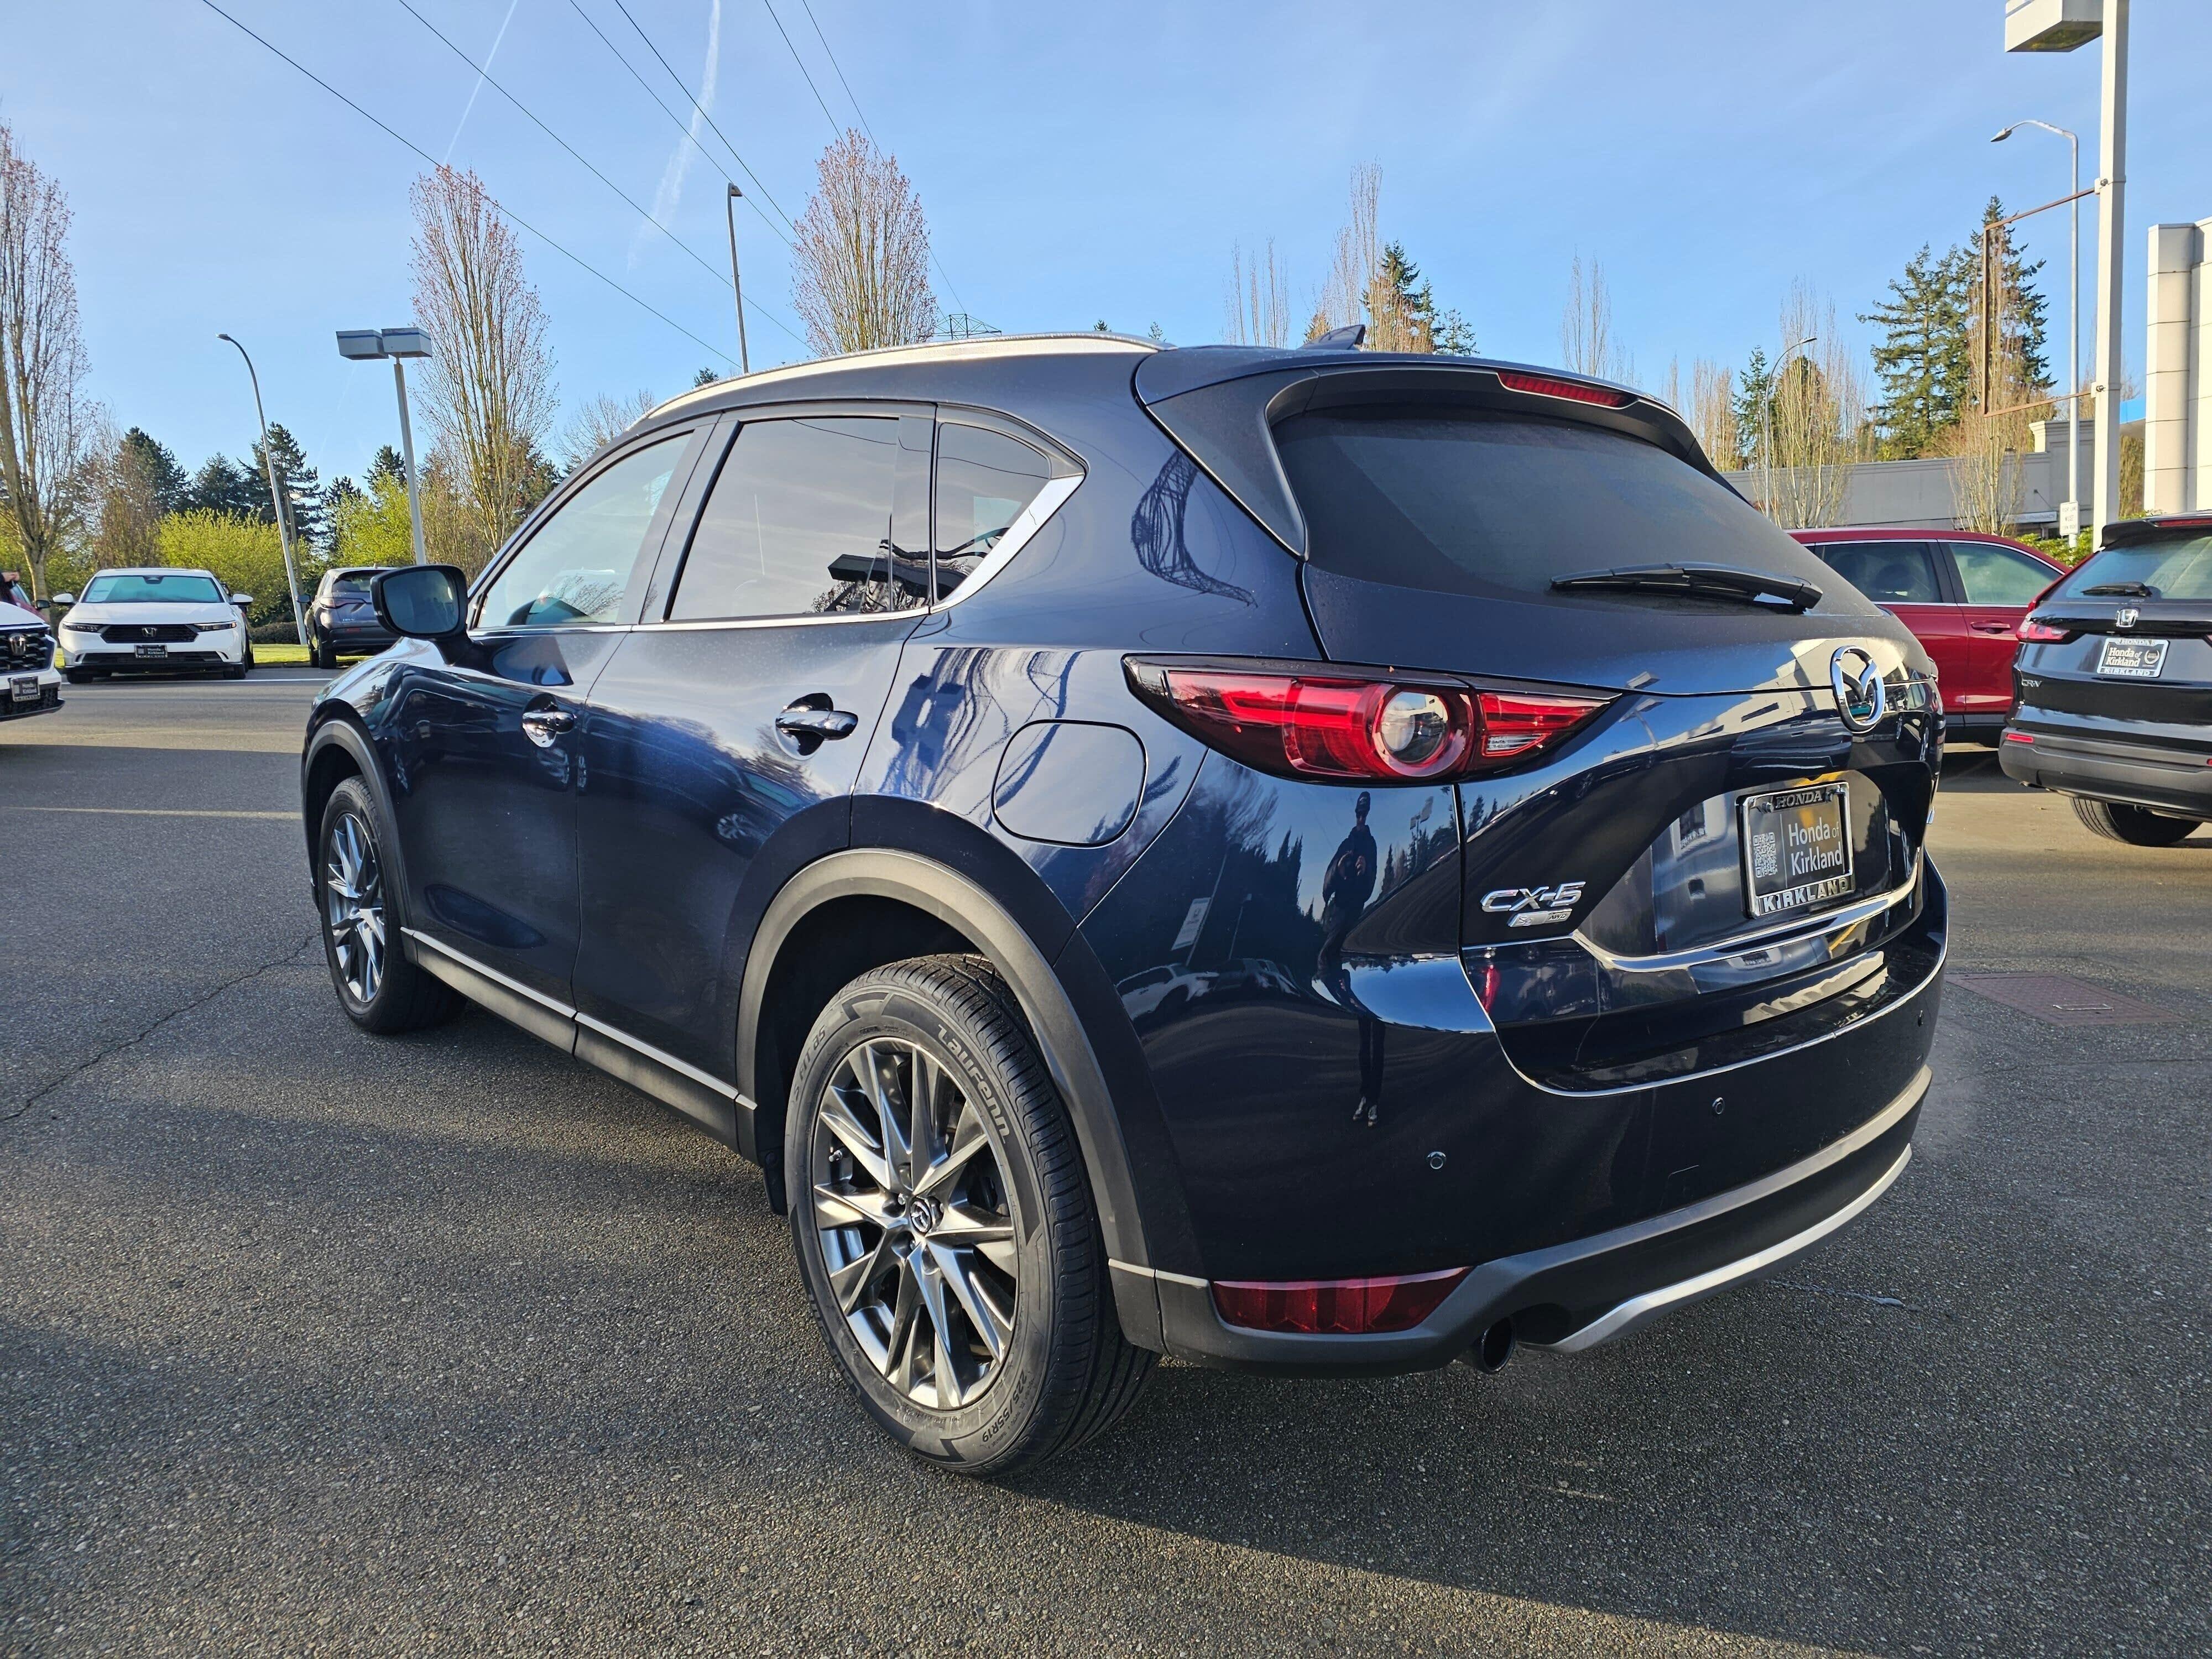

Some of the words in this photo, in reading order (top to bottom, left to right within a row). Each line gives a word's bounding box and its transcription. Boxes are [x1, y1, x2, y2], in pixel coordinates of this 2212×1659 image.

[2105, 656, 2141, 667] Kirkland
[2108, 647, 2135, 658] Honda
[1775, 790, 1823, 809] HONDA
[1788, 817, 1830, 847] Honda
[1832, 821, 1839, 838] of
[1791, 841, 1843, 876] Kirkland
[1480, 881, 1586, 912] CX-5
[1763, 878, 1849, 912] KIRKLAND
[938, 1024, 1010, 1144] Laufenn
[982, 1369, 1027, 1443] 225/55R19
